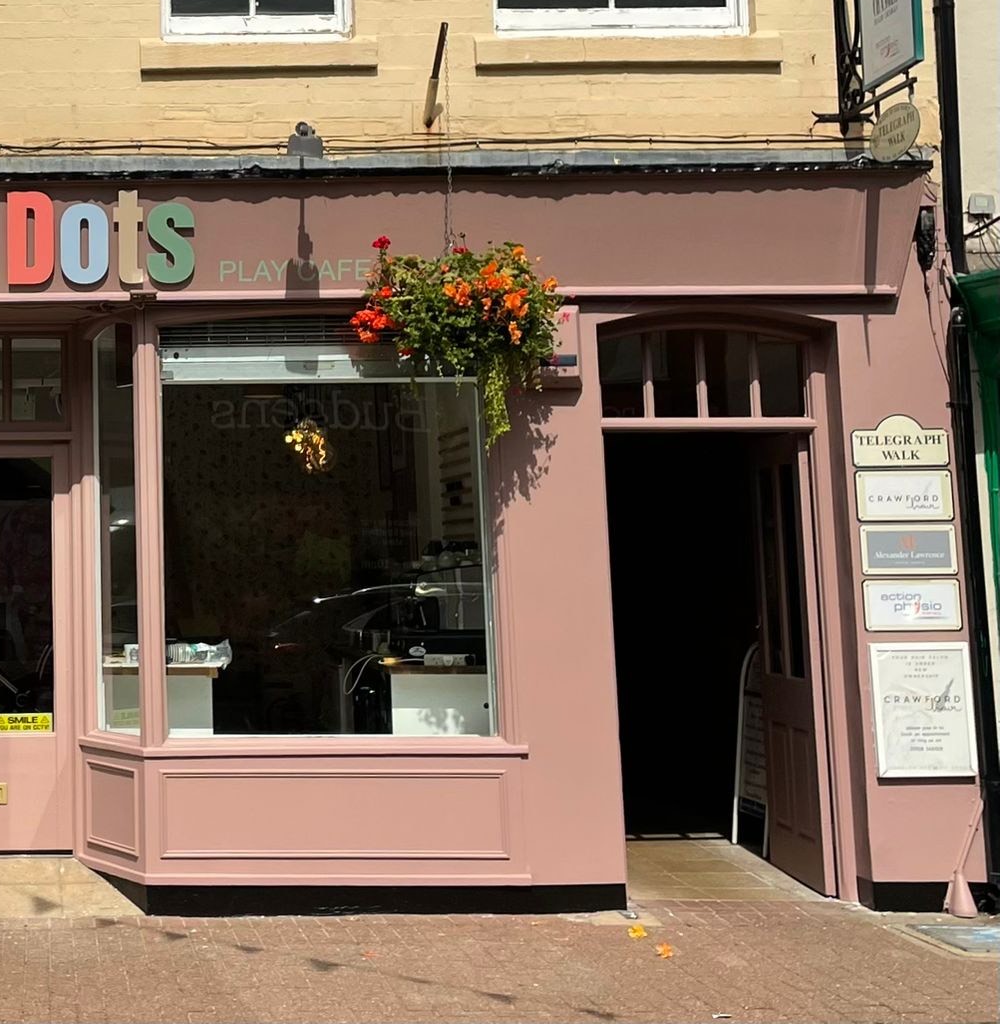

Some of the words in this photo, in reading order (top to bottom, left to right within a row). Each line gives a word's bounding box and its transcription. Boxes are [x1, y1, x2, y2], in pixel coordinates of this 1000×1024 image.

[879, 111, 915, 136] TELEGRAPH
[888, 132, 906, 146] WALK
[6, 189, 195, 285] Dots
[219, 259, 289, 283] PLAY
[300, 258, 373, 281] CAFE
[858, 434, 943, 446] TELEGRAPH
[881, 450, 921, 461] WALK
[868, 494, 940, 503] CRAWFORD
[875, 551, 909, 560] Alexander
[911, 551, 945, 560] Lawrence
[880, 591, 922, 602] action
[883, 695, 961, 704] CRAWFORD
[7, 716, 38, 725] SMILE
